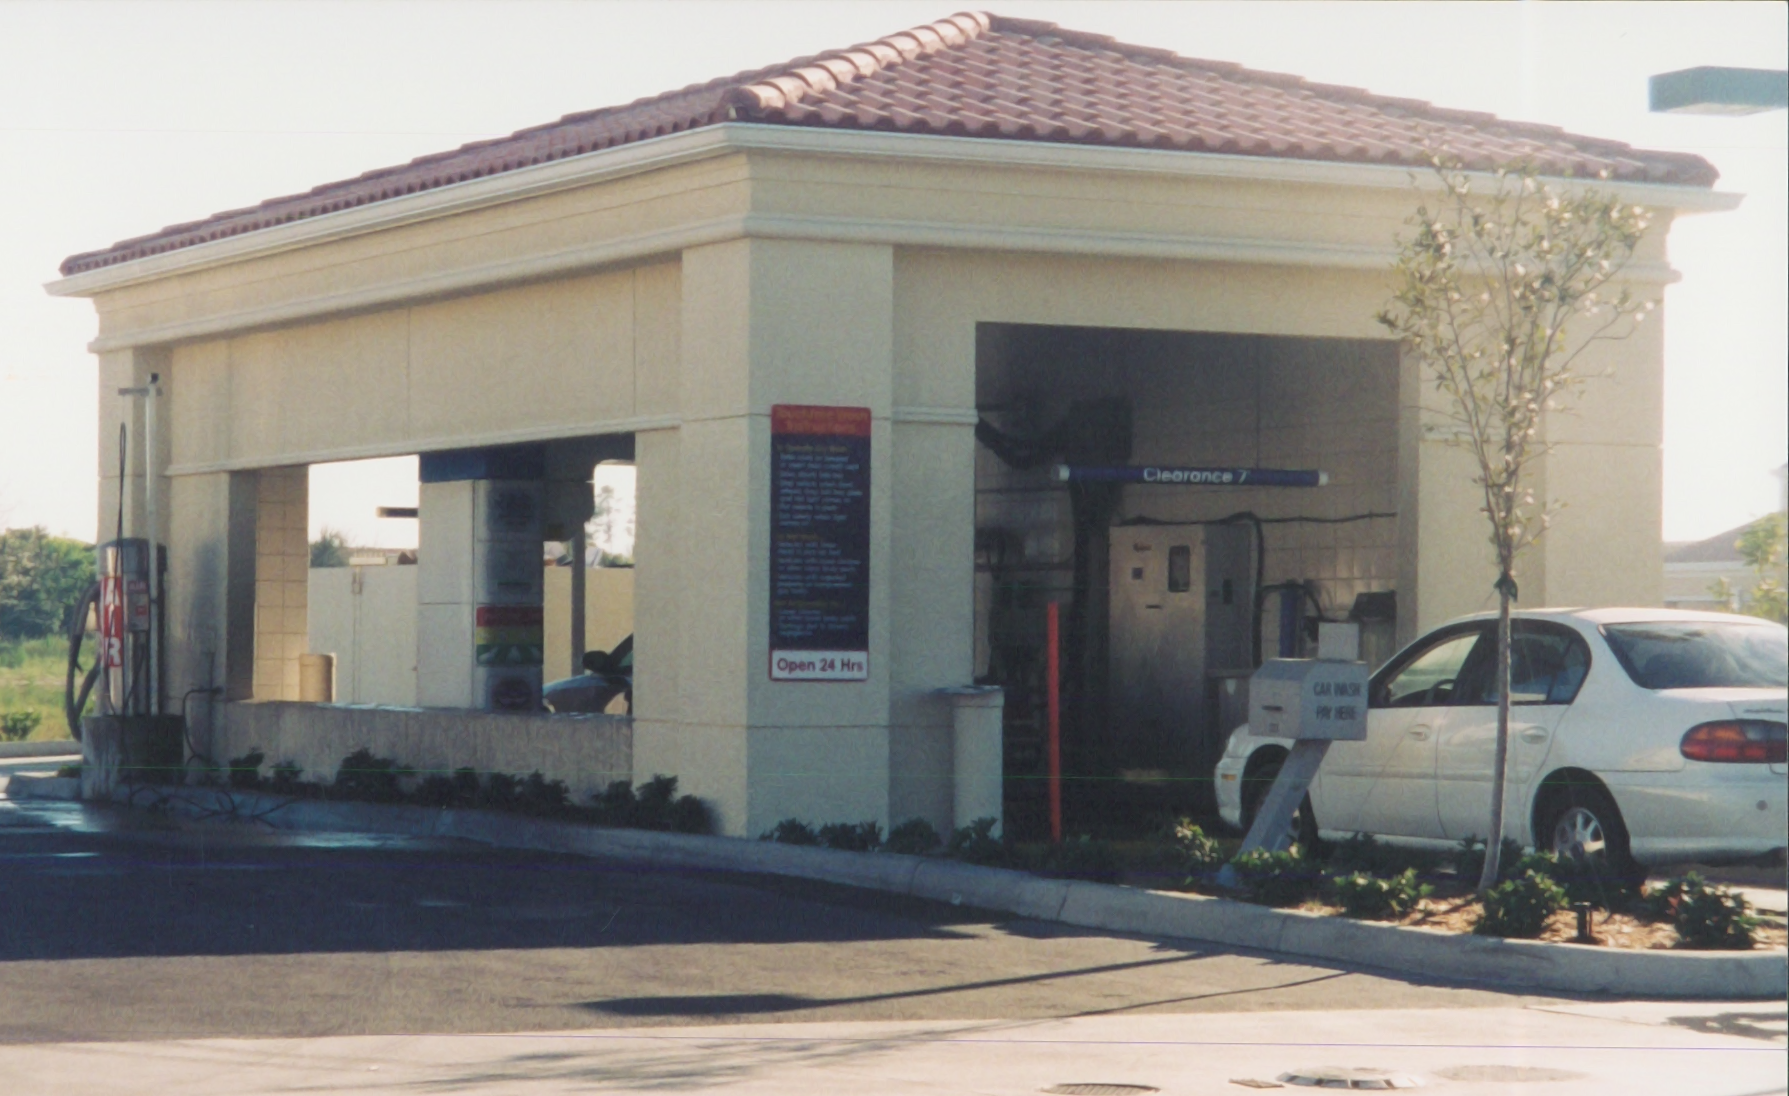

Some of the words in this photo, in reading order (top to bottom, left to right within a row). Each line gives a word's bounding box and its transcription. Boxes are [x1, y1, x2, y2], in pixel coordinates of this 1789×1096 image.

[1143, 468, 1233, 483] Clearance
[104, 577, 121, 665] AIR
[777, 657, 816, 675] Open
[819, 658, 836, 672] 24
[840, 658, 864, 673] Hrs
[1313, 681, 1332, 696] CAR
[1334, 681, 1361, 697] WASH
[1316, 705, 1332, 720] PAY
[1334, 705, 1357, 720] HERE
